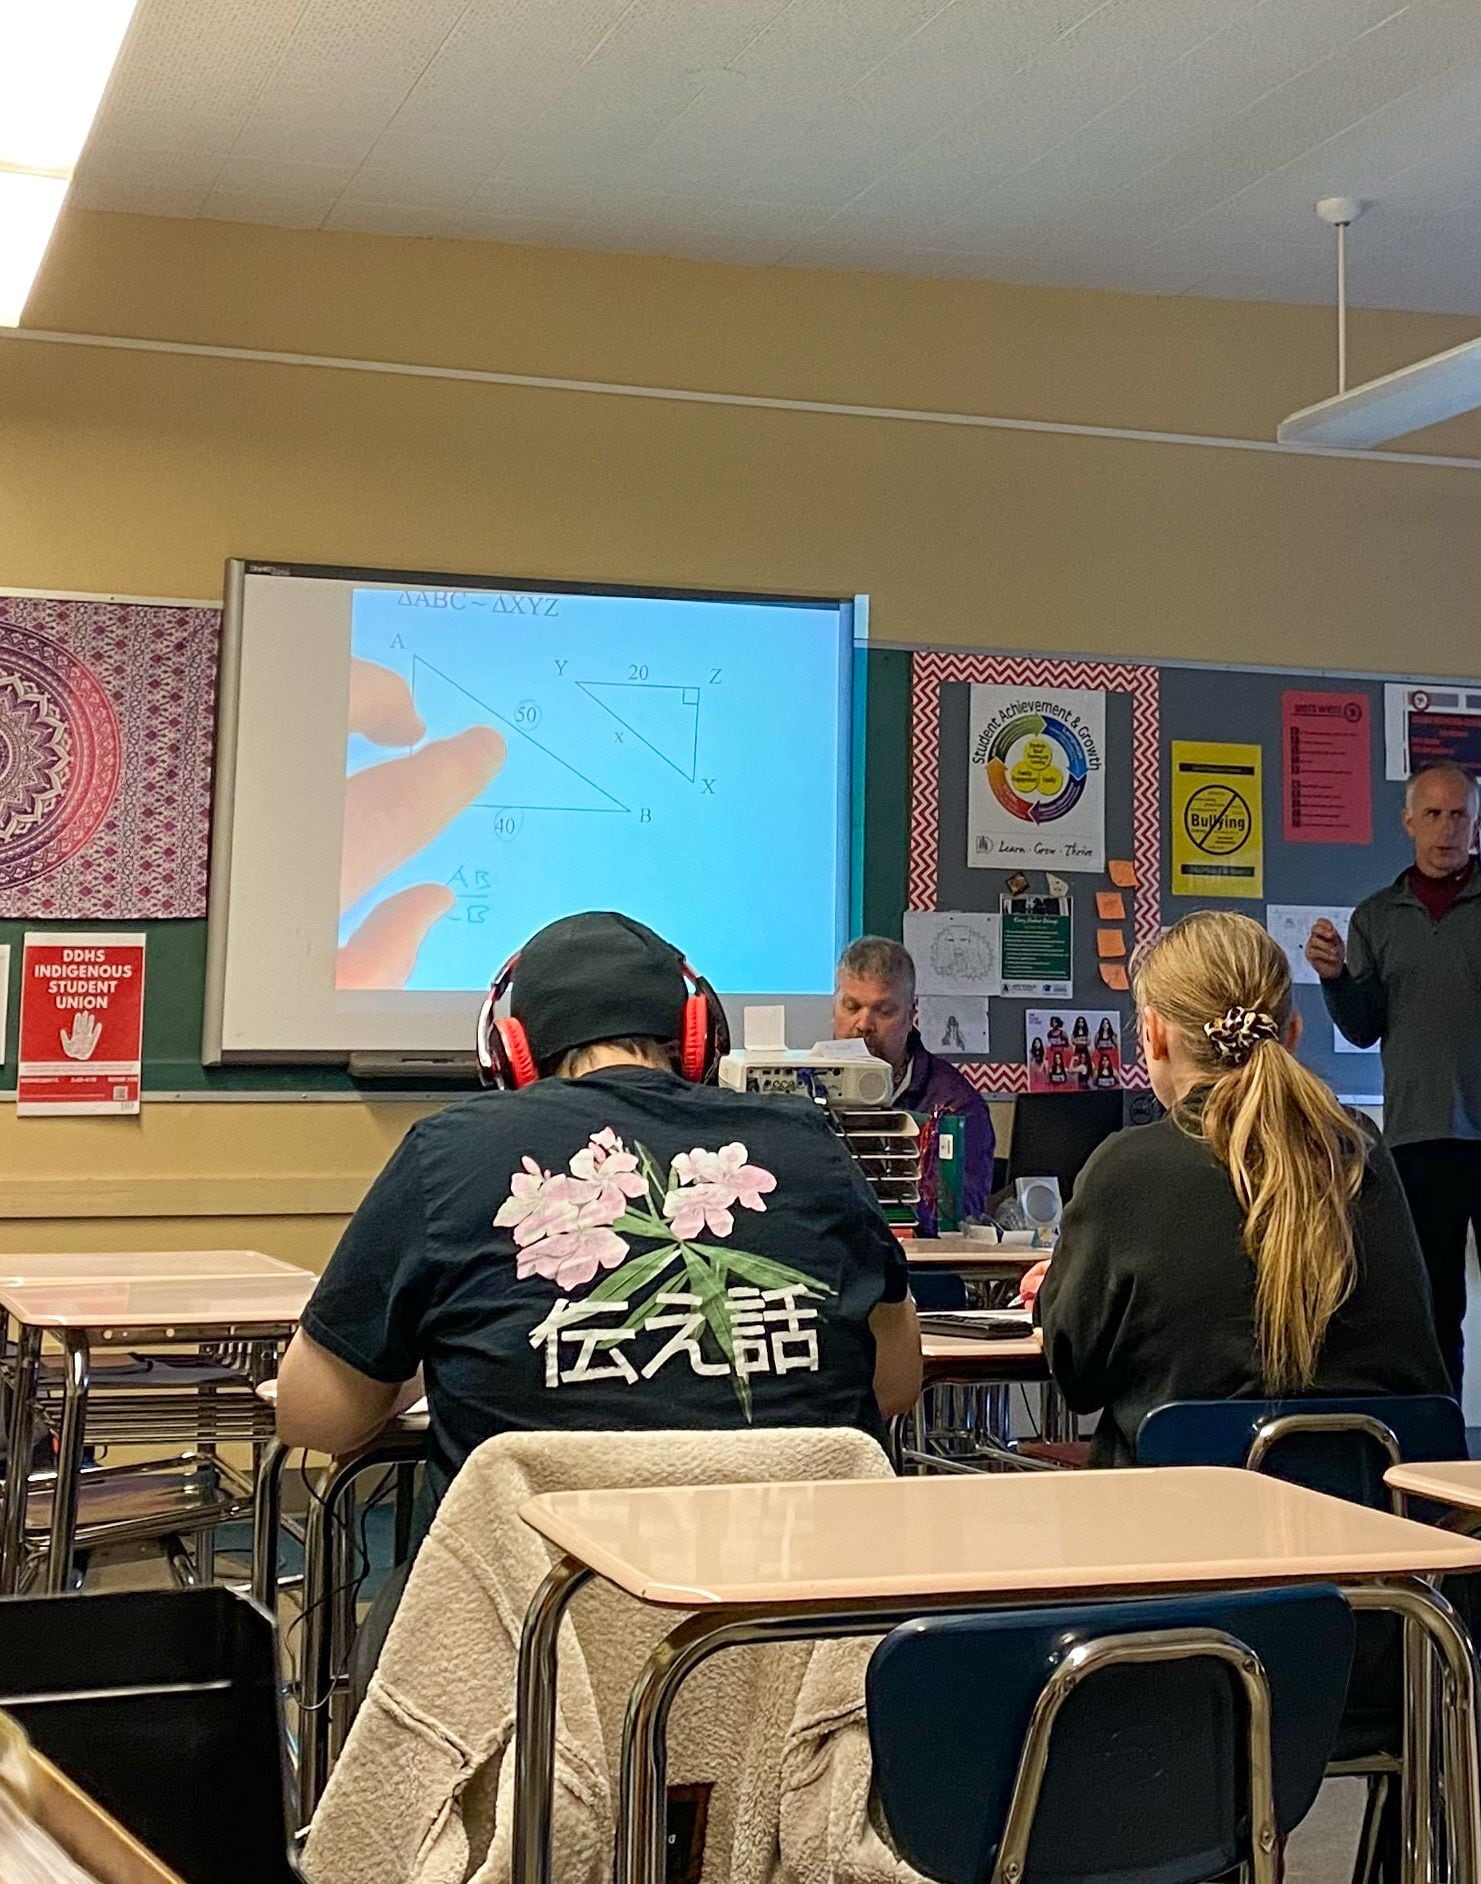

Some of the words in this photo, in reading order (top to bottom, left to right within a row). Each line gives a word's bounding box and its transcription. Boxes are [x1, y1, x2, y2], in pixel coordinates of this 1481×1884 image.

[390, 633, 406, 649] A
[555, 660, 568, 676] Y
[628, 664, 649, 680] 20
[709, 668, 722, 684] Z
[515, 706, 537, 723] 50
[972, 716, 1001, 765] Student
[998, 700, 1072, 723] Achievement
[1070, 716, 1081, 729] &
[1078, 726, 1102, 771] Growth
[701, 779, 717, 794] X
[640, 808, 652, 823] B
[1191, 812, 1246, 831] Bullying
[494, 818, 515, 834] 40
[998, 840, 1026, 853] Learn
[1033, 841, 1056, 855] Grow
[1064, 842, 1094, 857] Thrive
[63, 949, 106, 962] DDHS
[34, 964, 133, 979] INDIGENOUS
[48, 980, 118, 994] STUDENT
[55, 996, 109, 1010] UNION
[529, 1283, 819, 1388] 伝え話
